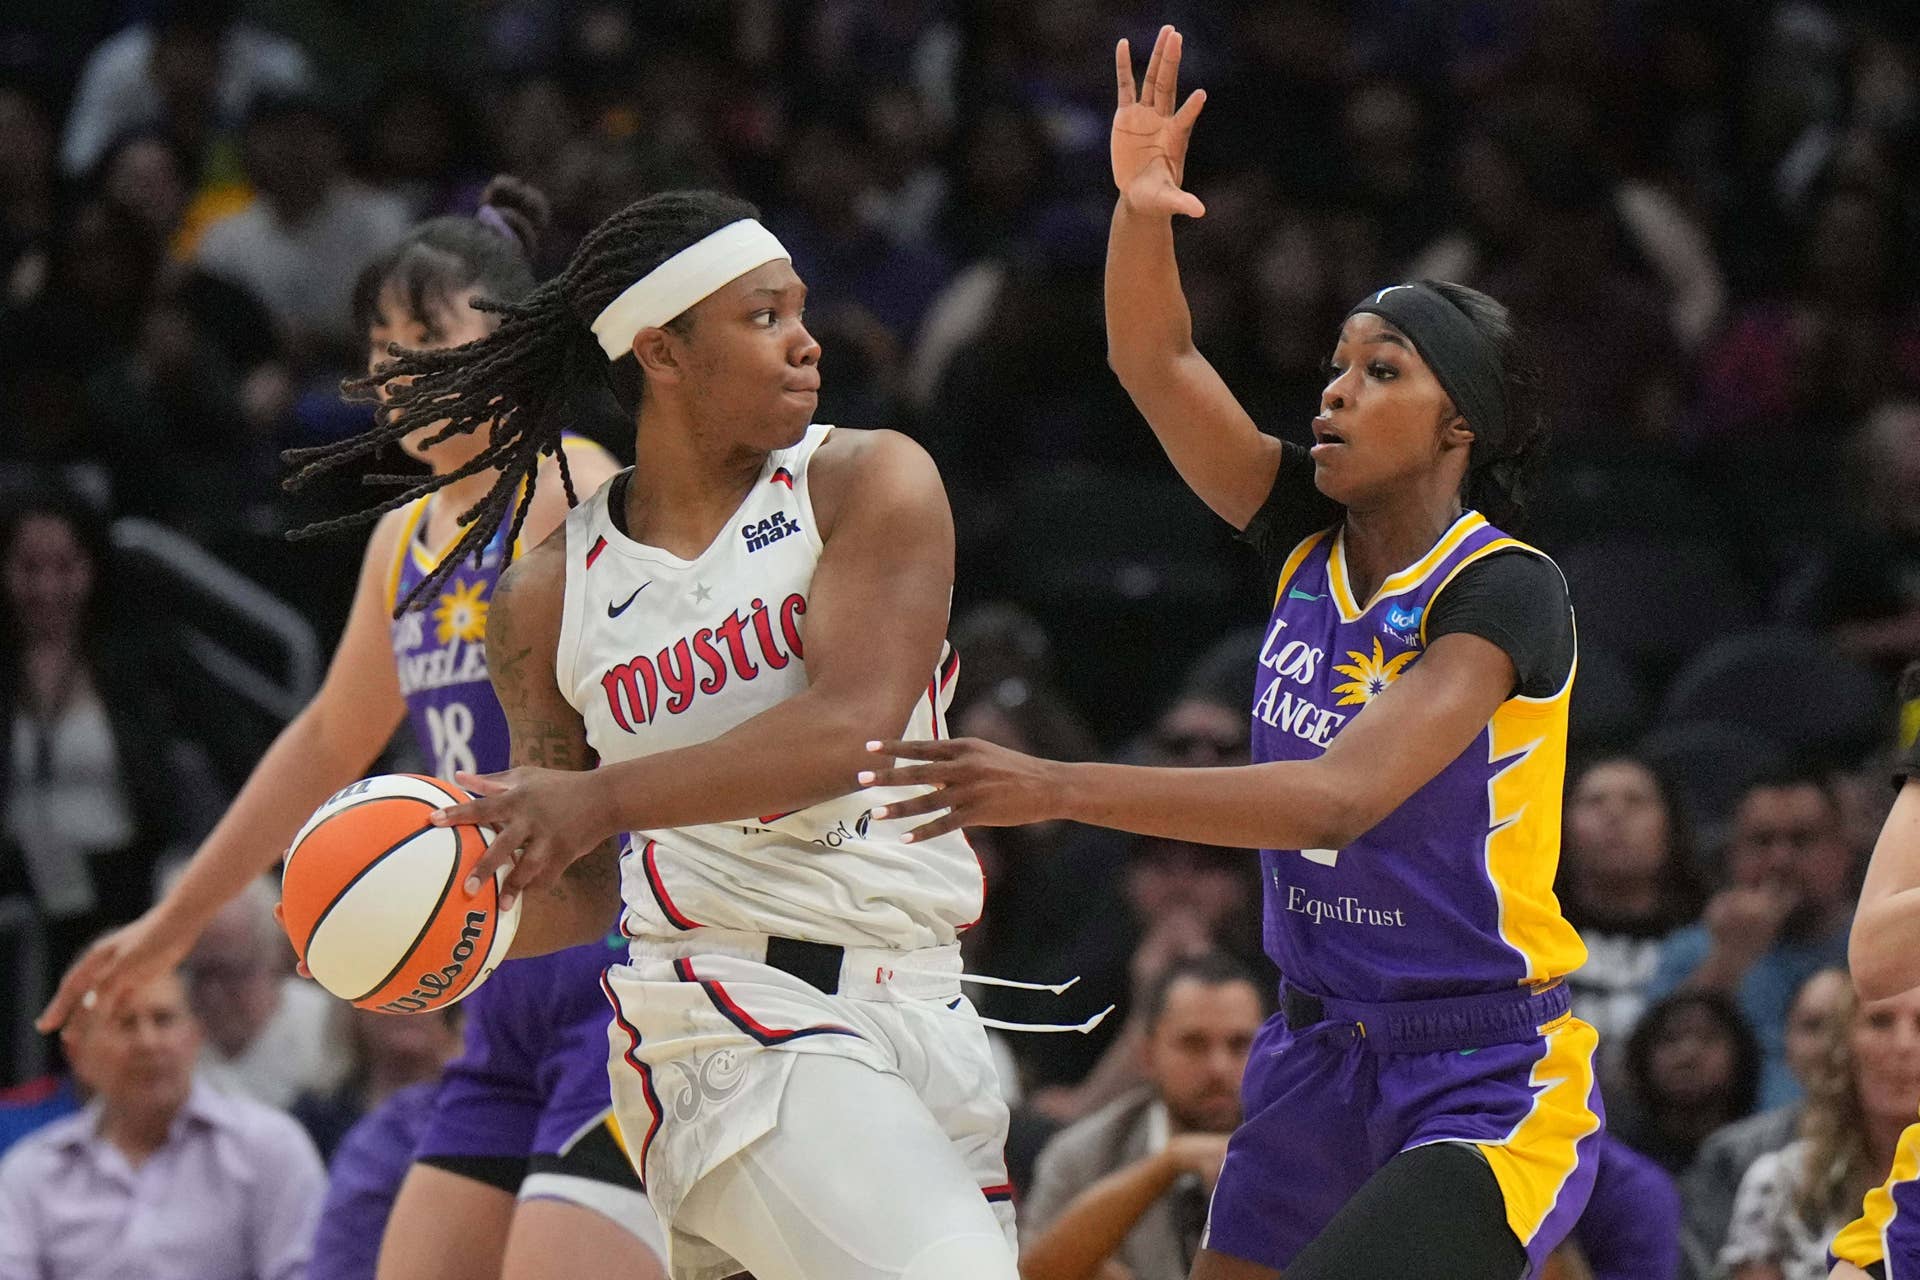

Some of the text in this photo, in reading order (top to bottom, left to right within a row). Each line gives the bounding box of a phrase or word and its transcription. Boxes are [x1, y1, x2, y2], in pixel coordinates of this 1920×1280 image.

[741, 510, 786, 539] CAR
[746, 518, 802, 553] max
[1258, 618, 1325, 685] LOS
[425, 702, 478, 789] 18
[1251, 676, 1347, 750] ANGE
[1286, 884, 1407, 928] EquiTrust
[375, 909, 487, 1013] Wilson
